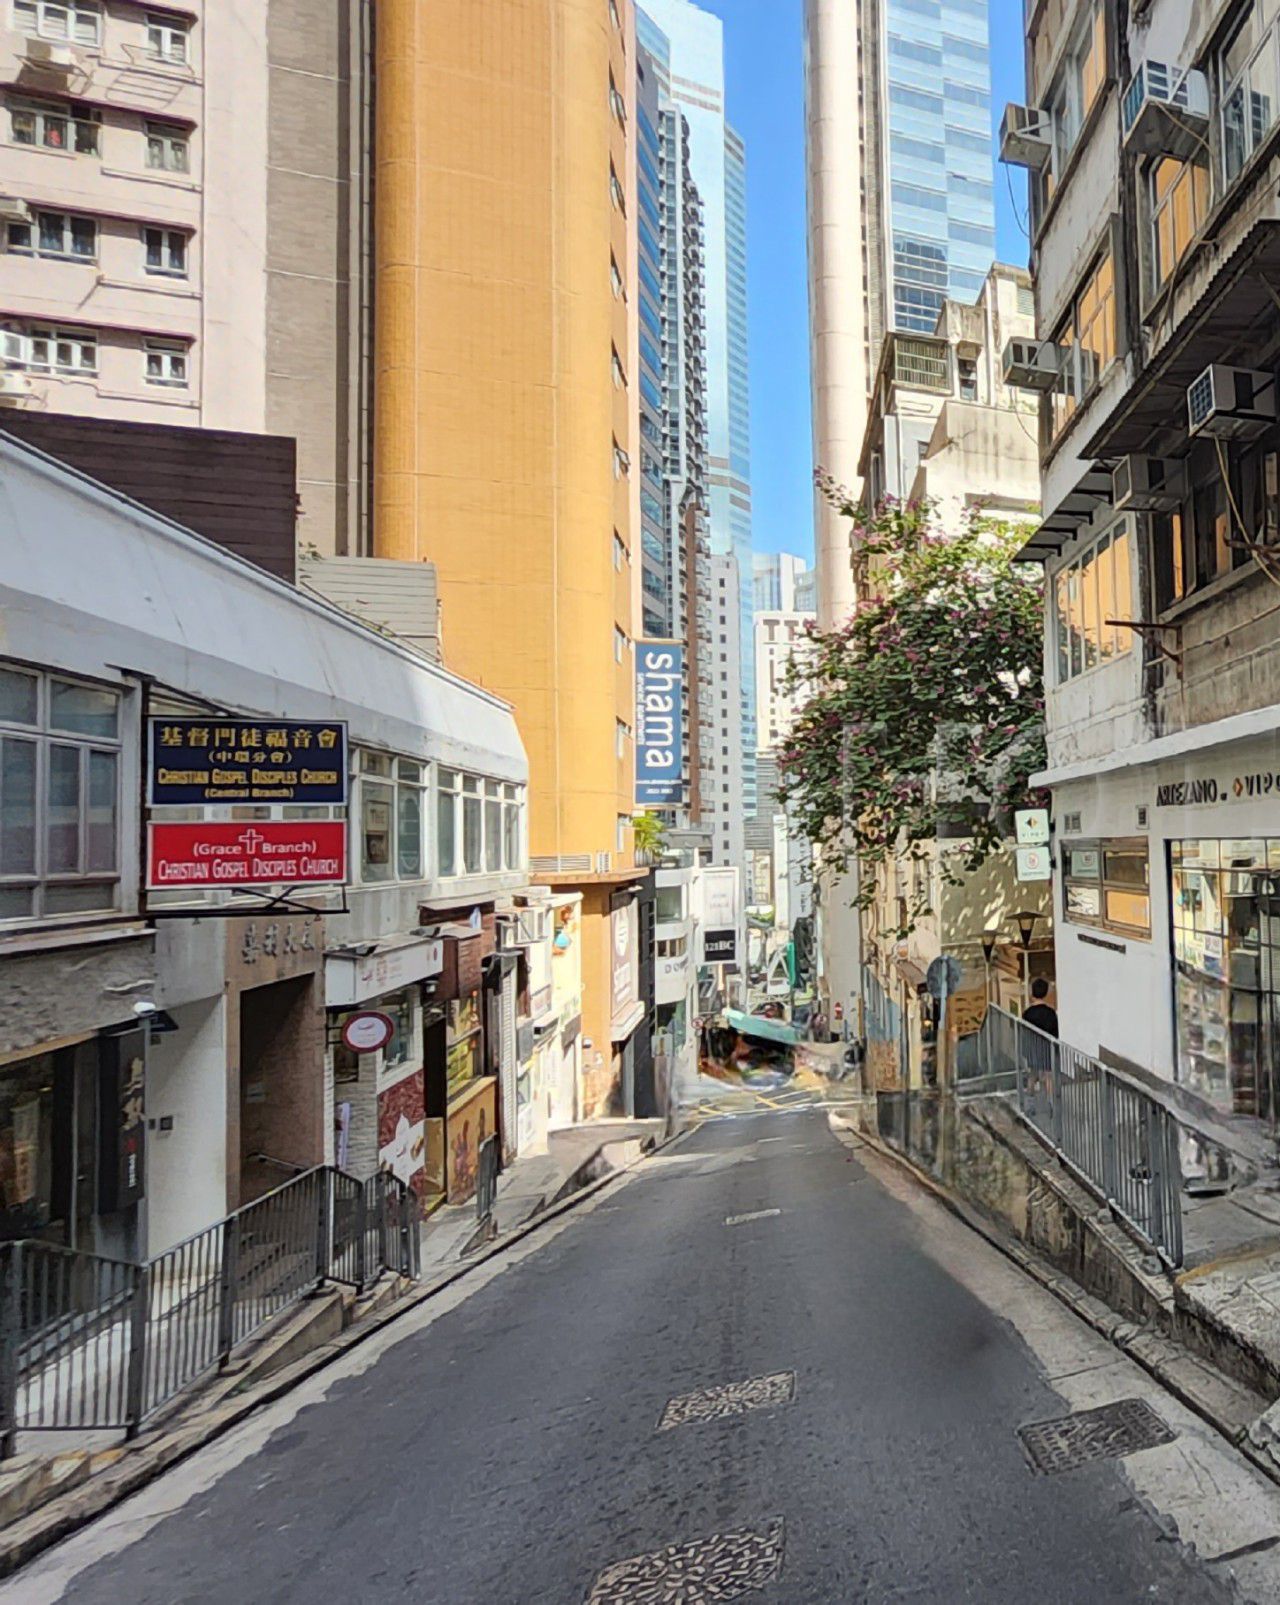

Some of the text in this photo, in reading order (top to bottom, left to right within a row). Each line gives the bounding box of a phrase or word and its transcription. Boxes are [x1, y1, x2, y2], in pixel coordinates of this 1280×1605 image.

[645, 651, 683, 767] shama
[160, 726, 337, 748] 基督門徒福音會
[193, 840, 318, 857] (Grace Branch)
